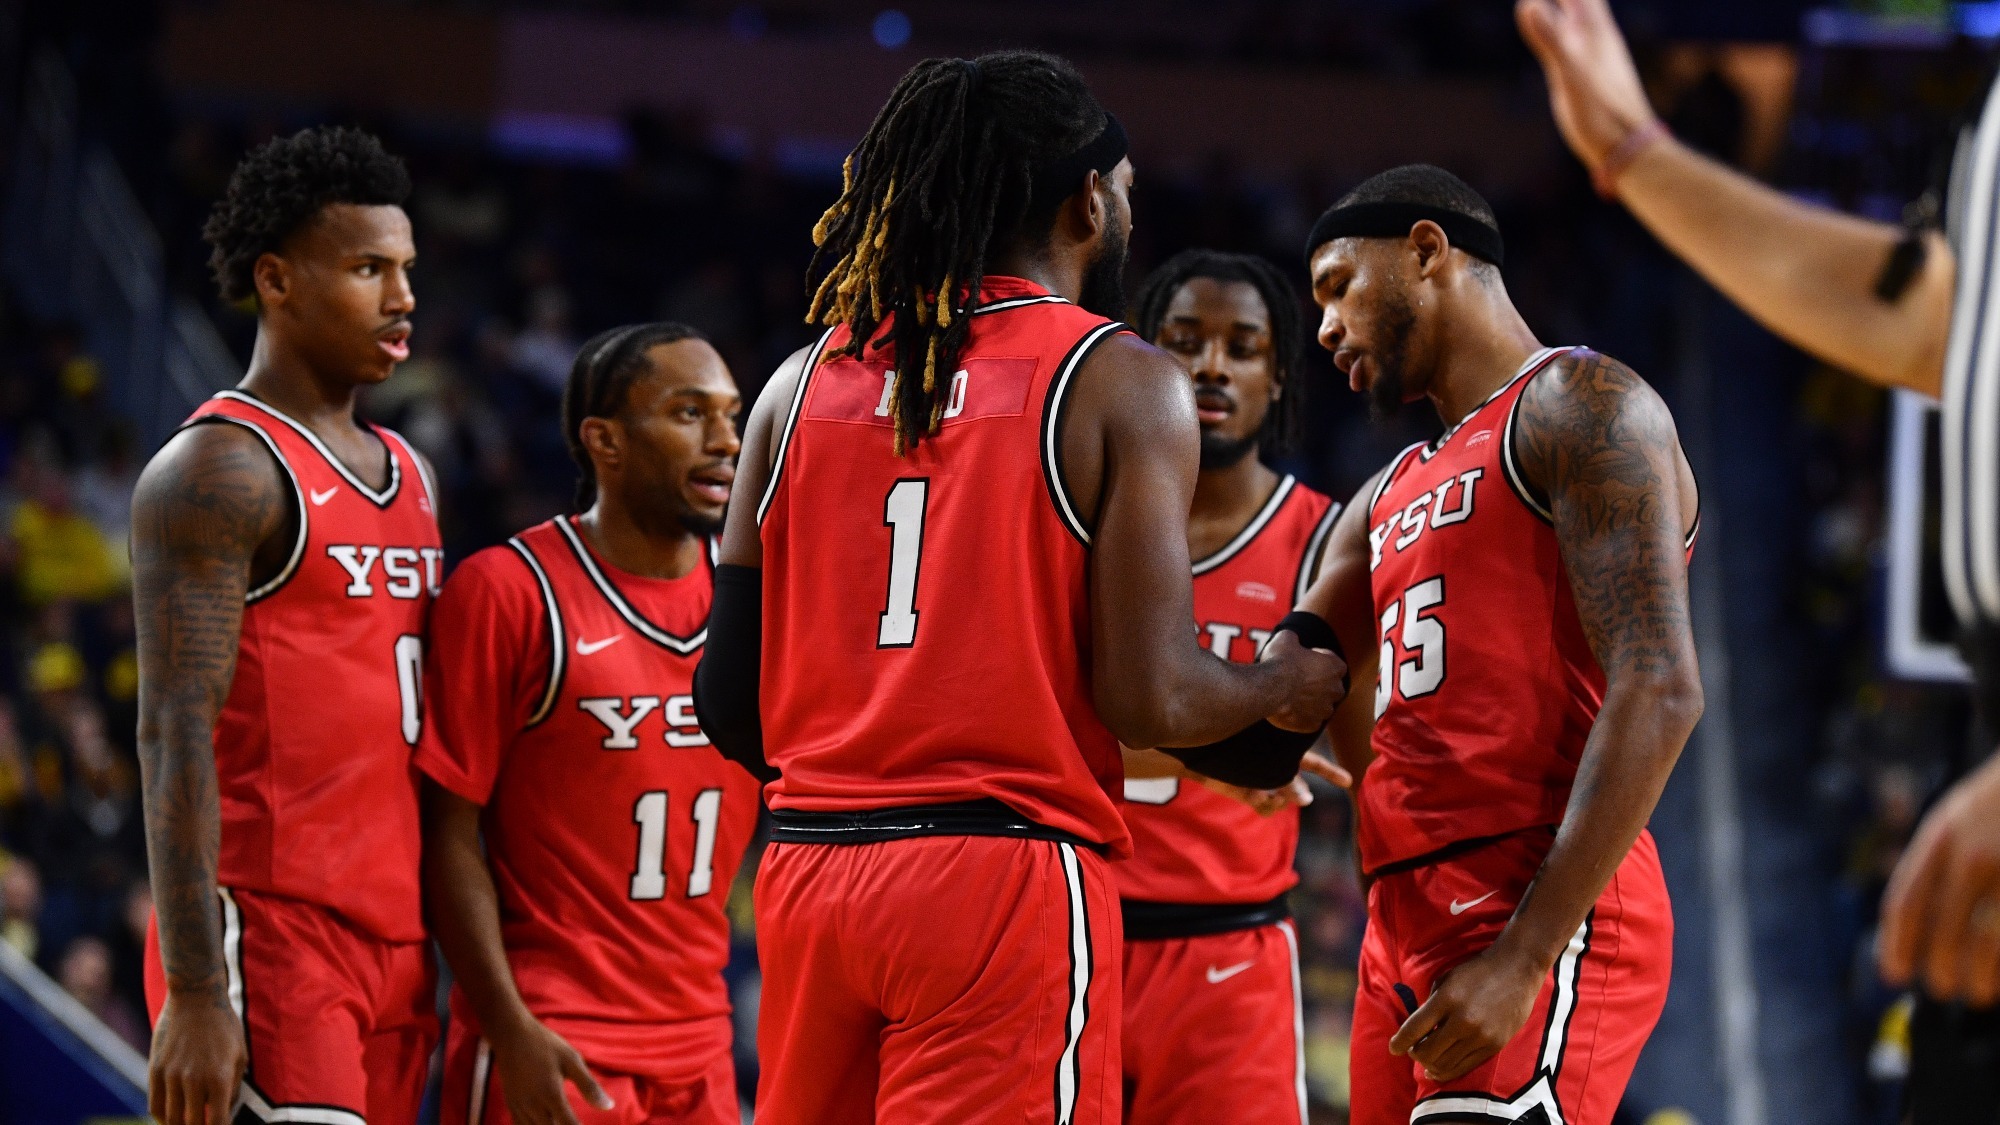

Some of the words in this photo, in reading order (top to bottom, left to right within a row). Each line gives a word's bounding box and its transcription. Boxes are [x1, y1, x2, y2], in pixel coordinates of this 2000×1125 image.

[876, 477, 930, 649] 1
[1369, 466, 1485, 573] YSU
[1374, 573, 1447, 721] 55
[629, 788, 723, 901] 11
